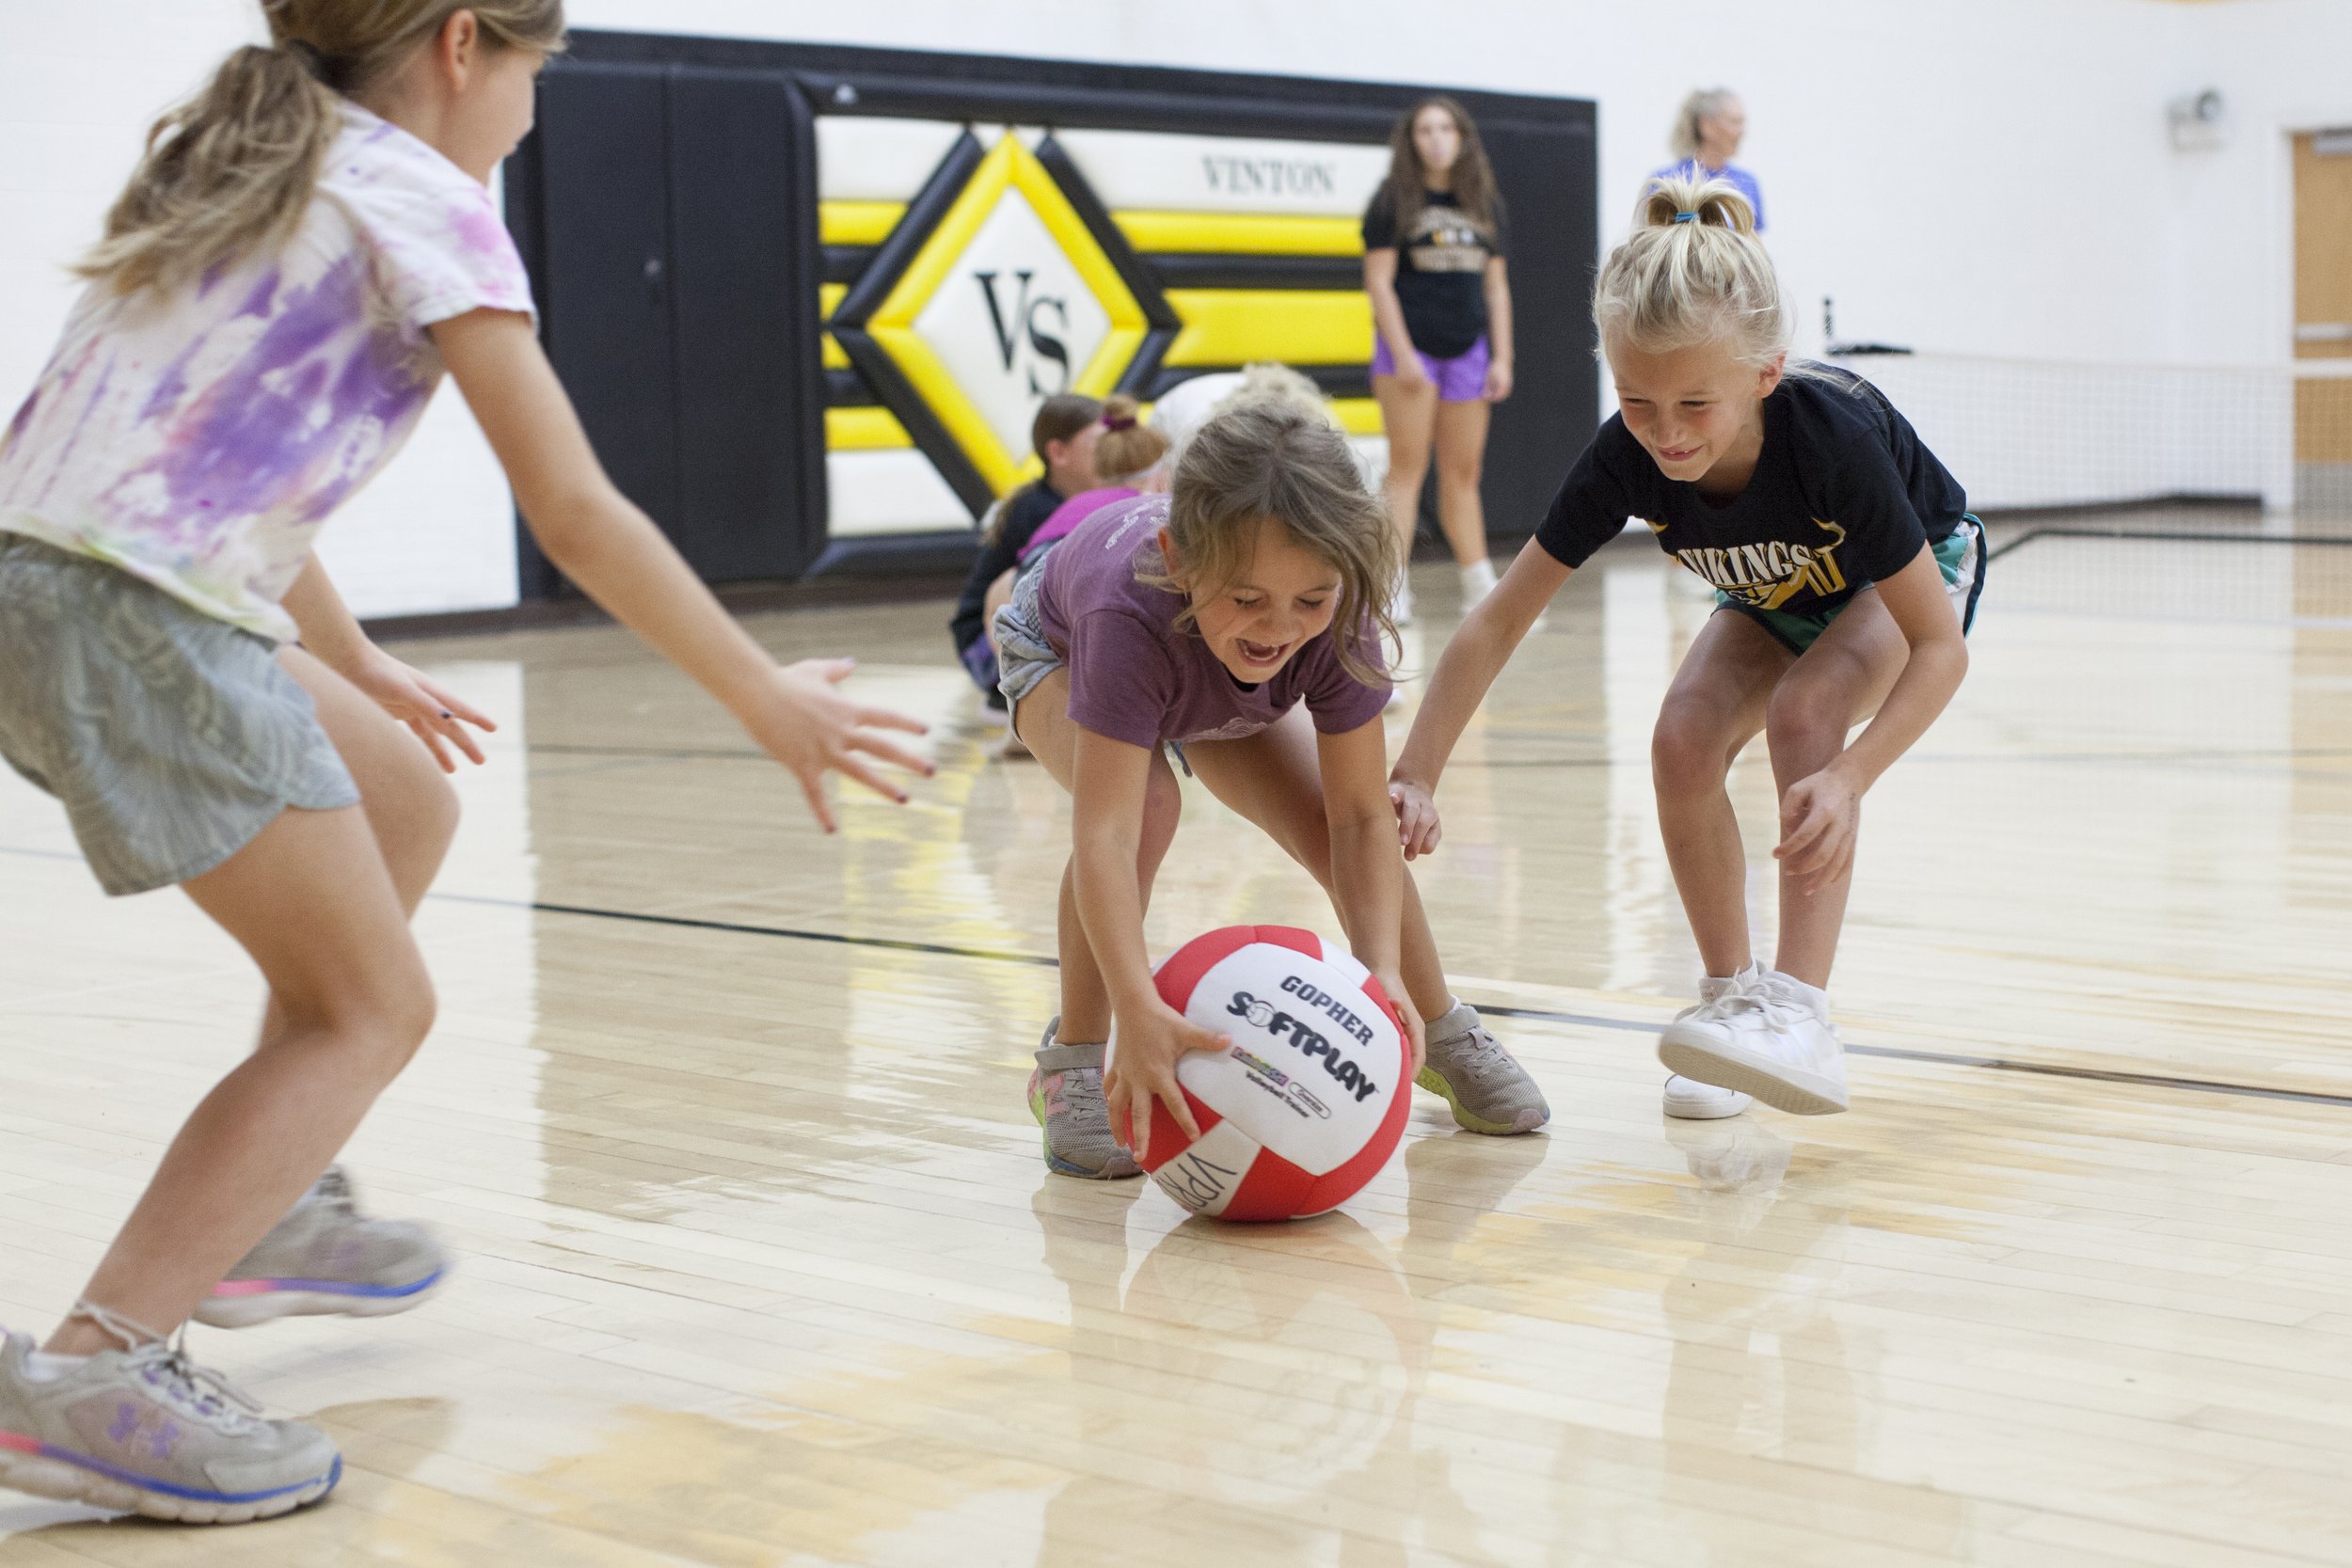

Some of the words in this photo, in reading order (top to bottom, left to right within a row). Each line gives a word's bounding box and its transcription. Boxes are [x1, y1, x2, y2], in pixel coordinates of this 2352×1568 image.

[1201, 156, 1335, 195] VINTON
[972, 270, 1069, 398] VS
[1677, 540, 1814, 587] VIKINGS
[1279, 975, 1375, 1047] GOPHER
[1226, 990, 1376, 1102] SOFTPLAY
[1155, 1151, 1237, 1212] VPR
